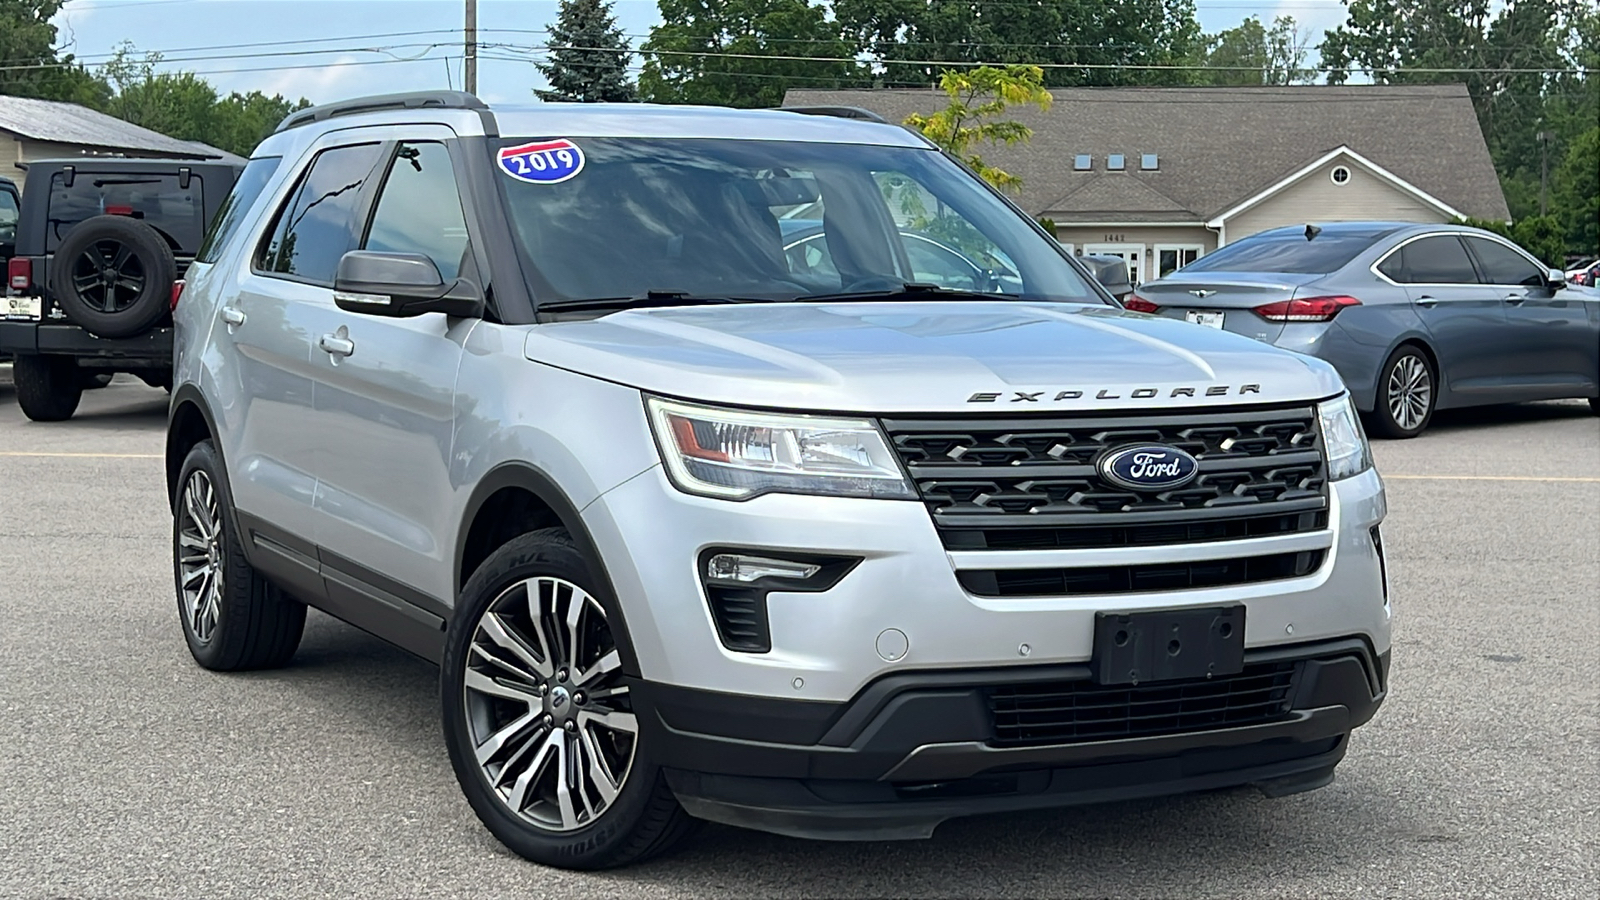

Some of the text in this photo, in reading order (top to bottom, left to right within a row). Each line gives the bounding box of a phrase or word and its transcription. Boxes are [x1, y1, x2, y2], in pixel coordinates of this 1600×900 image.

[510, 150, 573, 174] 2019
[967, 383, 1260, 402] EXPLORER
[1129, 452, 1181, 478] Ford
